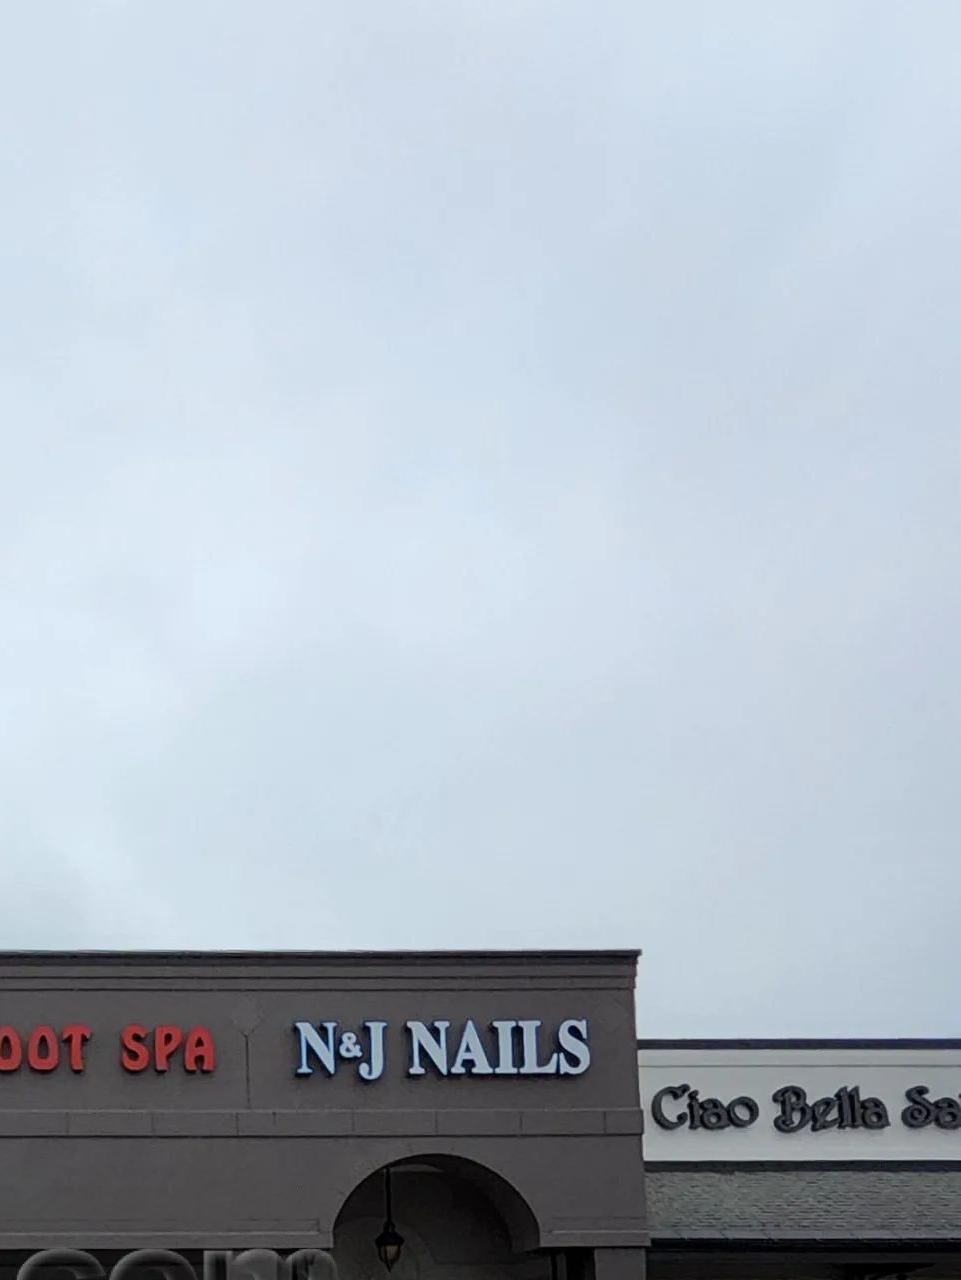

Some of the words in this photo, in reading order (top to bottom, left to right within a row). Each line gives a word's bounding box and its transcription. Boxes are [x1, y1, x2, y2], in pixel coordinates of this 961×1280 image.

[120, 1023, 216, 1073] SPA
[294, 1020, 388, 1081] N&J
[406, 1018, 591, 1077] NAILS
[651, 1083, 760, 1131] Ciao
[771, 1084, 891, 1133] Bella
[900, 1085, 961, 1131] Sa
